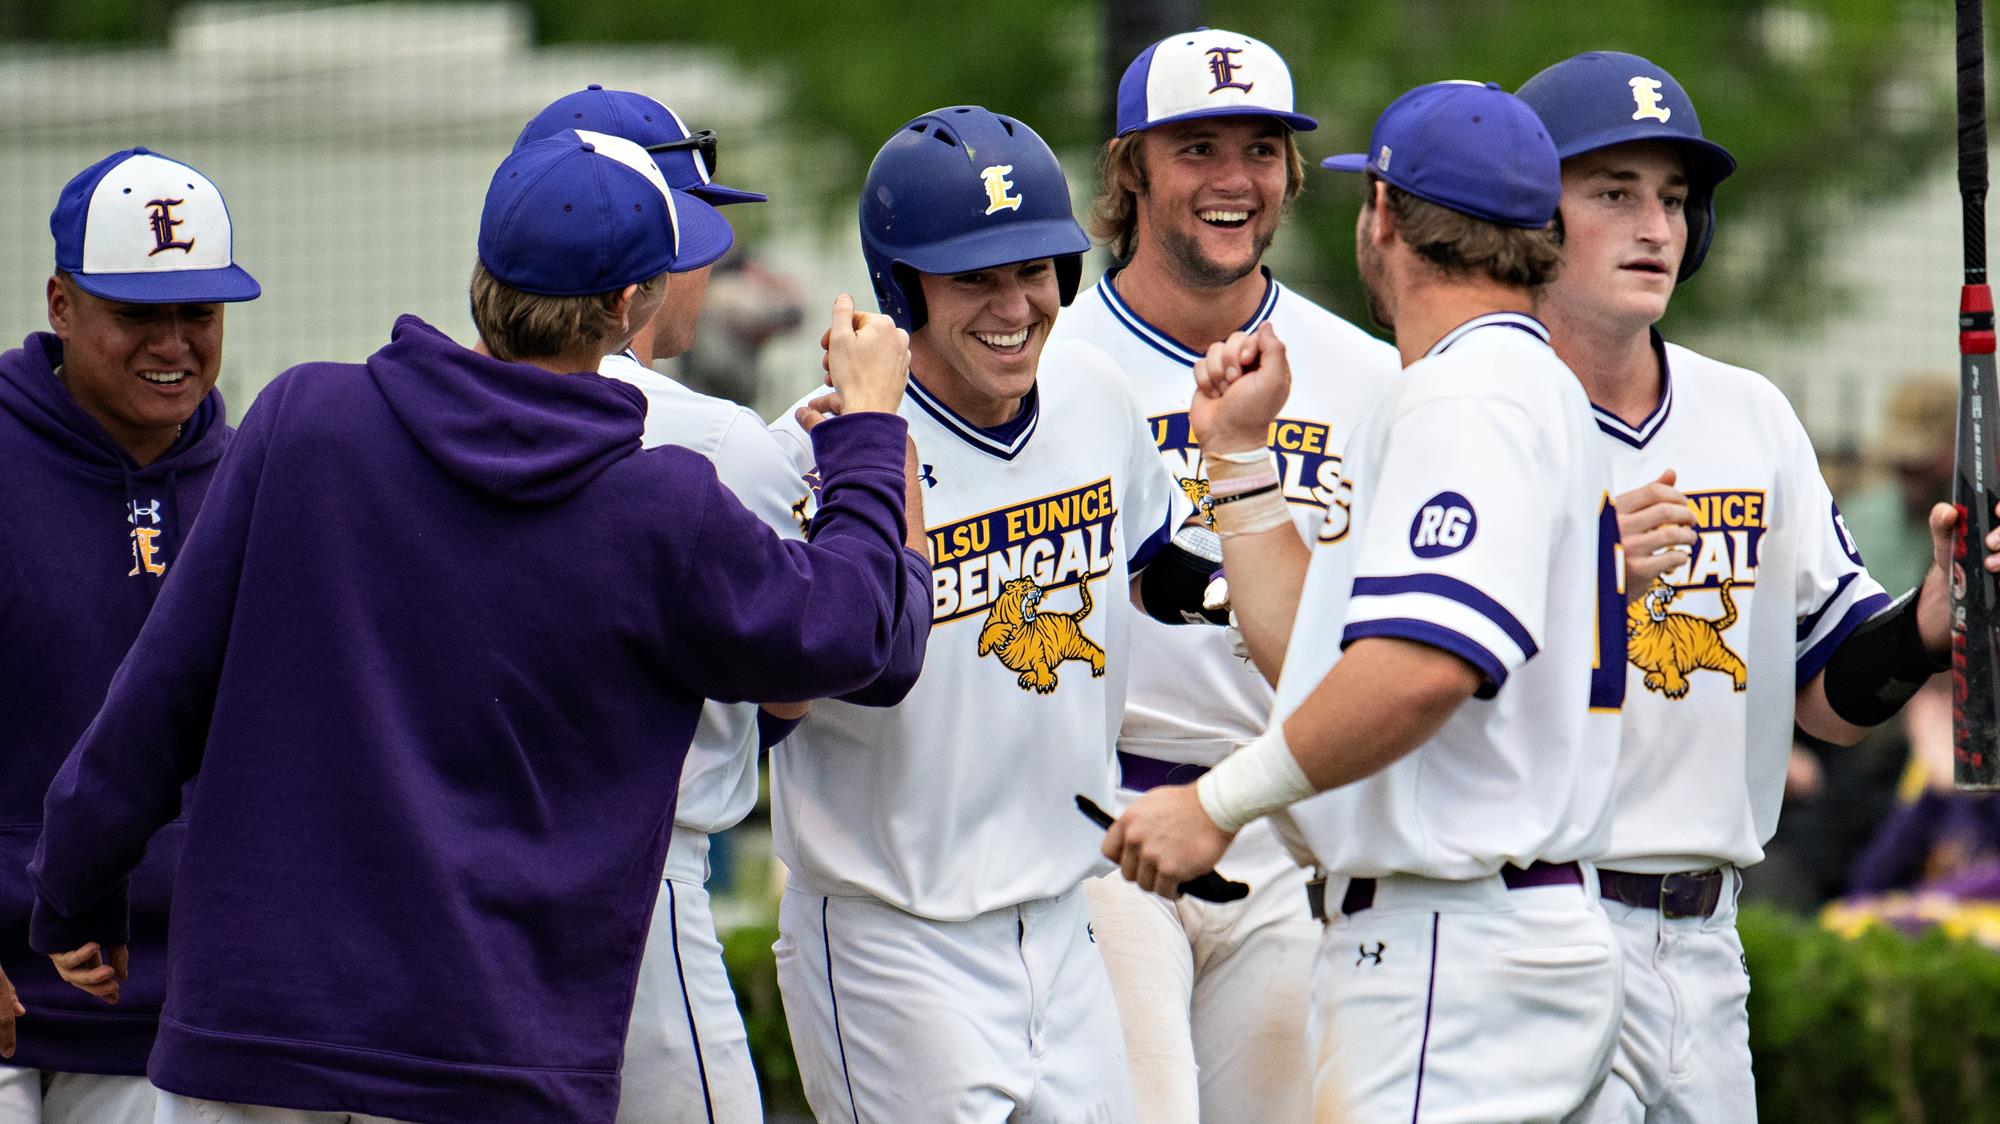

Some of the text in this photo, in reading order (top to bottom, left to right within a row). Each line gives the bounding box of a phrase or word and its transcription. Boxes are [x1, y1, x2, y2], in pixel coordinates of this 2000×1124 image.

[1204, 46, 1253, 94] E
[1628, 76, 1671, 123] E
[980, 164, 1022, 215] E
[144, 198, 195, 257] E
[935, 483, 1111, 566] LSU EUNICE
[1414, 505, 1472, 548] RG
[1685, 494, 1761, 528] NICE
[128, 527, 166, 577] E
